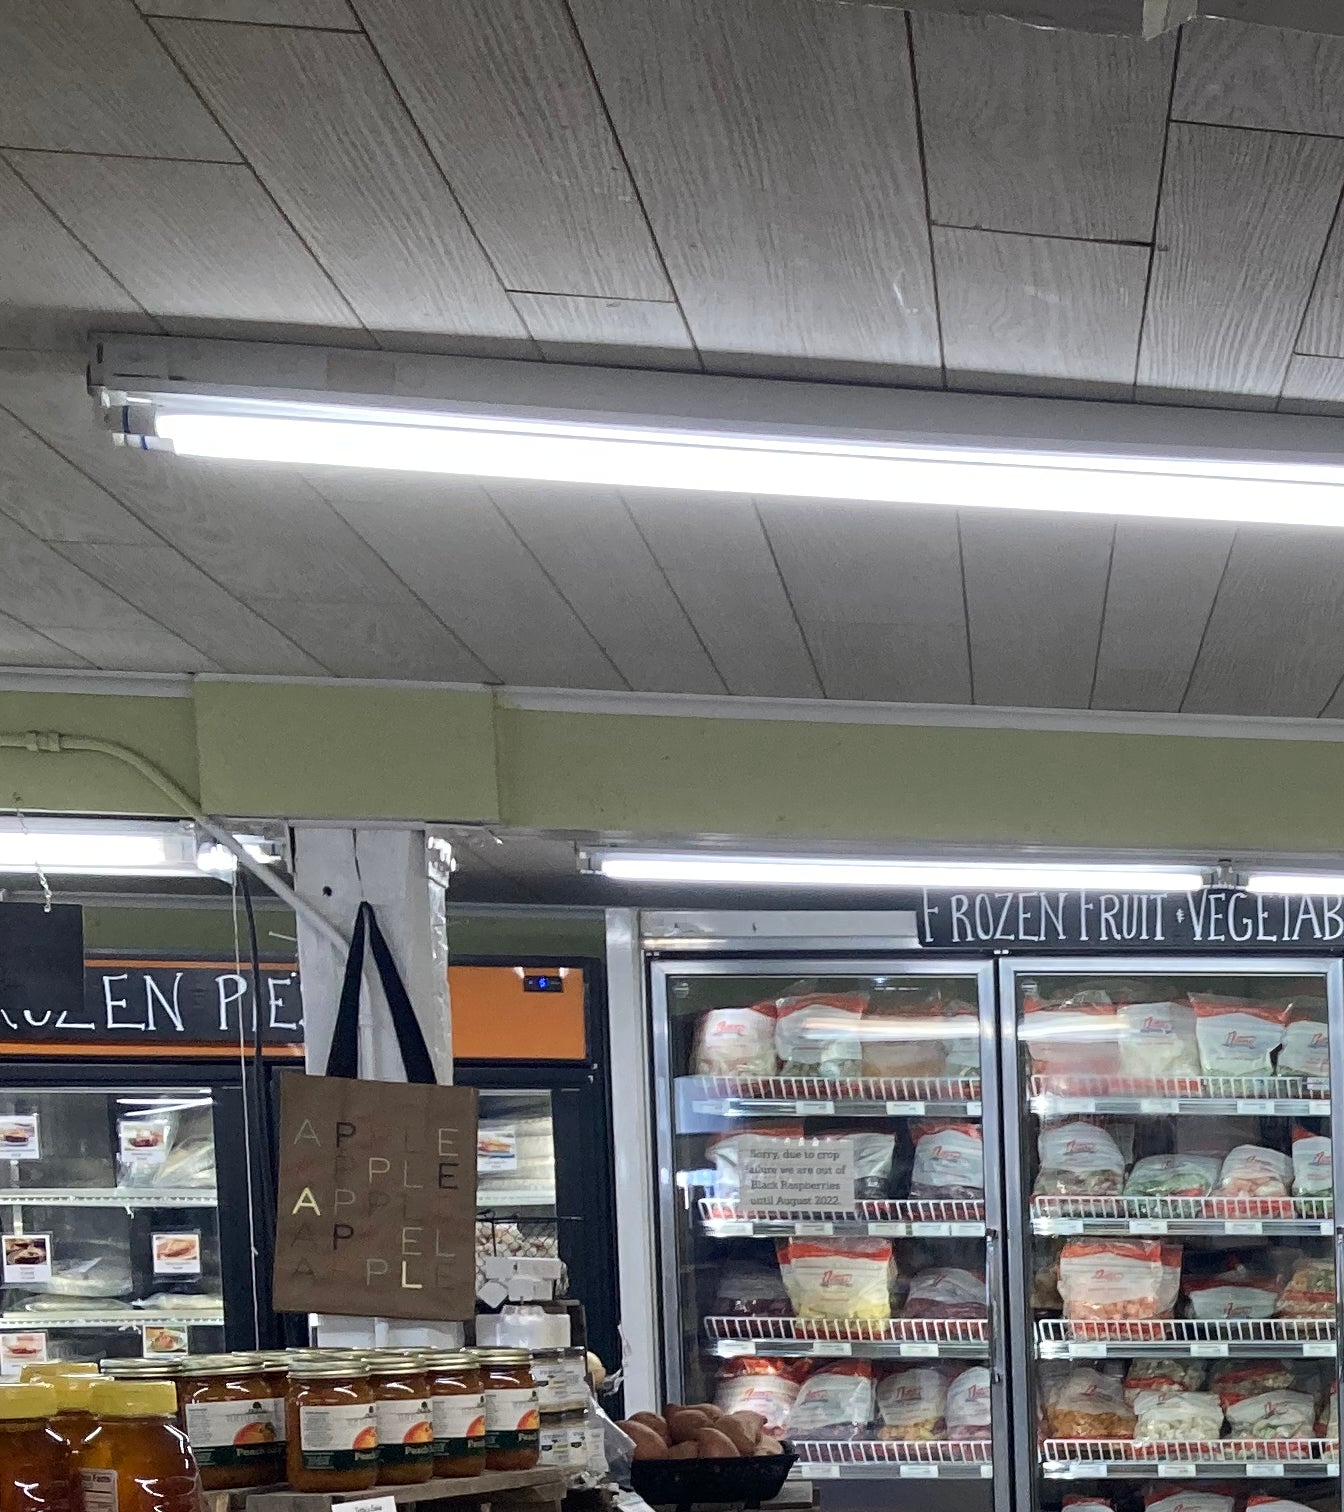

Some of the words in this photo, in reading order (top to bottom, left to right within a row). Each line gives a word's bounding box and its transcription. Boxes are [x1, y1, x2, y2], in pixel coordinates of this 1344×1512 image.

[922, 887, 1068, 943] FROZEN
[1079, 888, 1169, 941] FRUIT
[782, 1149, 802, 1159] due
[816, 1152, 840, 1161] crop
[751, 1179, 778, 1190] Black
[781, 1180, 841, 1192] Raspberries
[750, 1195, 774, 1205] until
[776, 1196, 812, 1207] August
